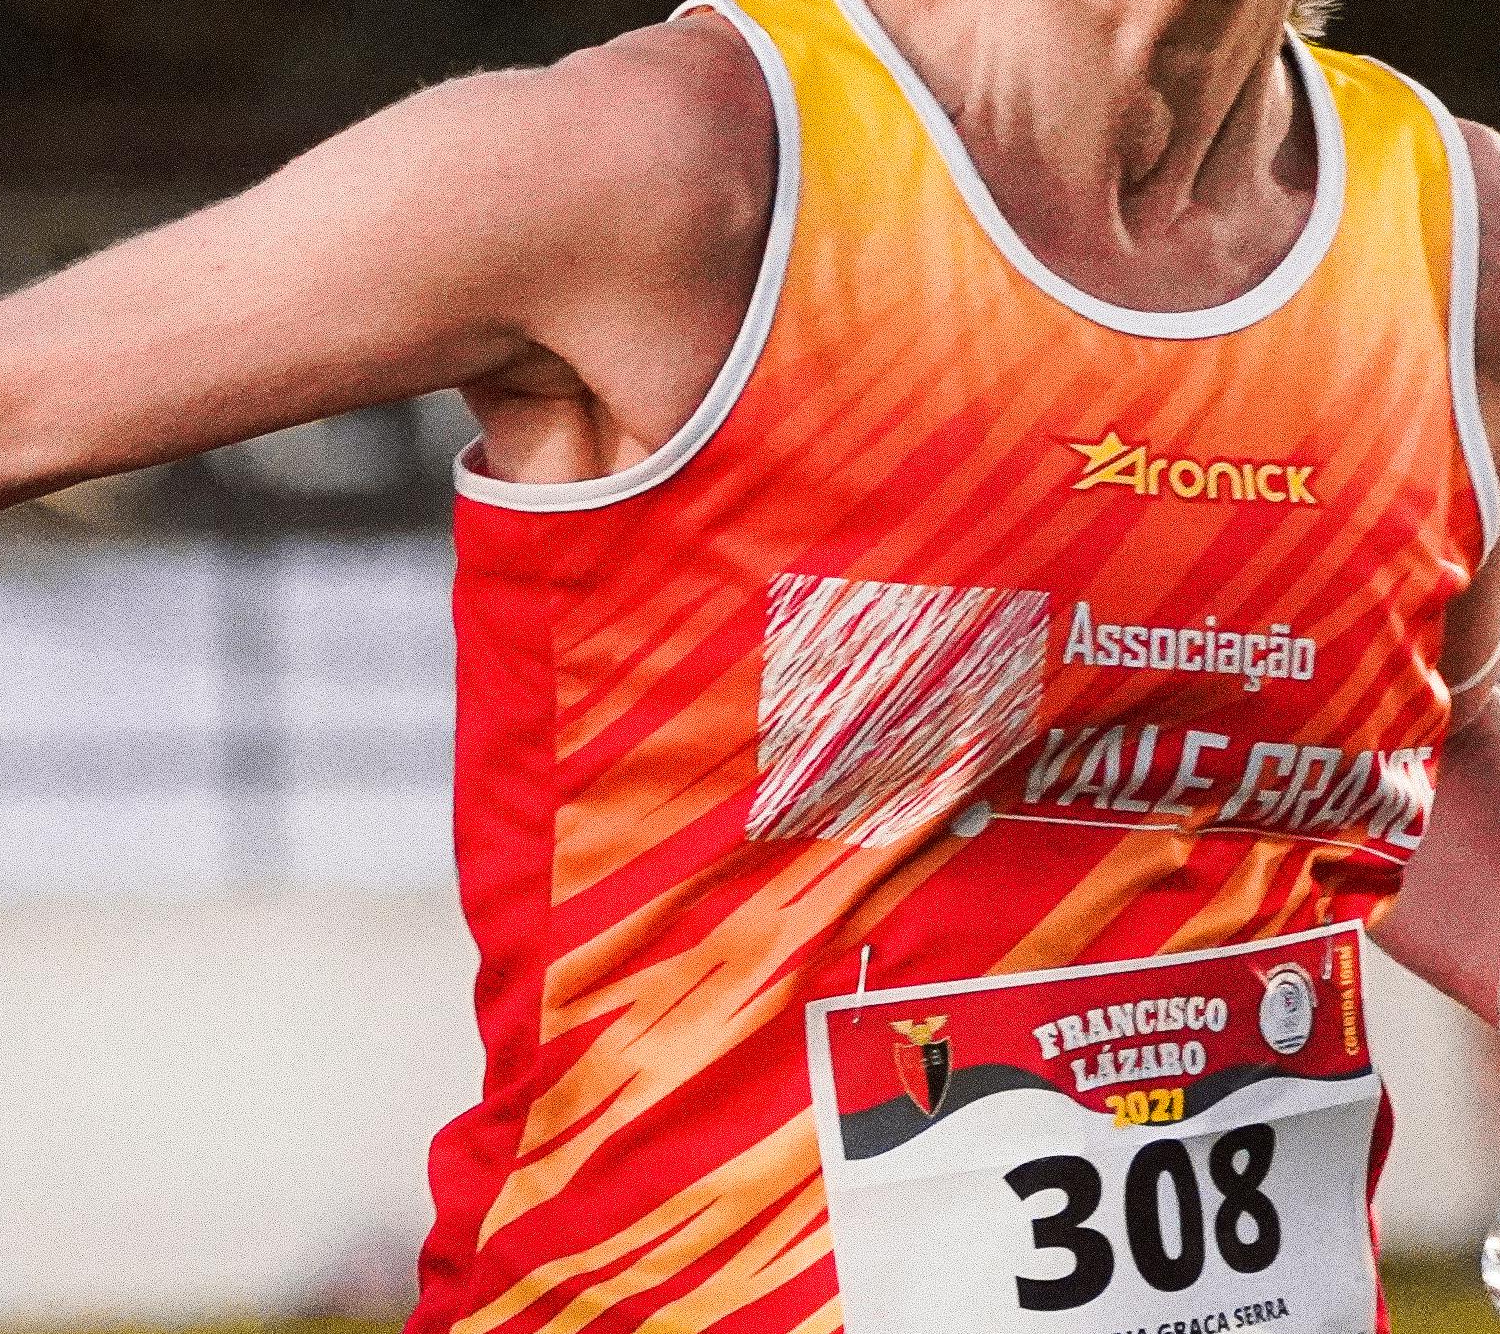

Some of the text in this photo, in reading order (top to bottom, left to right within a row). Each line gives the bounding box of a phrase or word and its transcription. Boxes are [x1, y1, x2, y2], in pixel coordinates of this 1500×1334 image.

[1063, 600, 1316, 691] Associação
[1023, 722, 1230, 817] VALE
[1032, 994, 1229, 1061] FRANCISCO
[1070, 1040, 1207, 1093] LÁZARO
[1105, 1087, 1186, 1128] 2021
[1004, 1122, 1283, 1312] 308
[1234, 1297, 1290, 1328] SERRA
